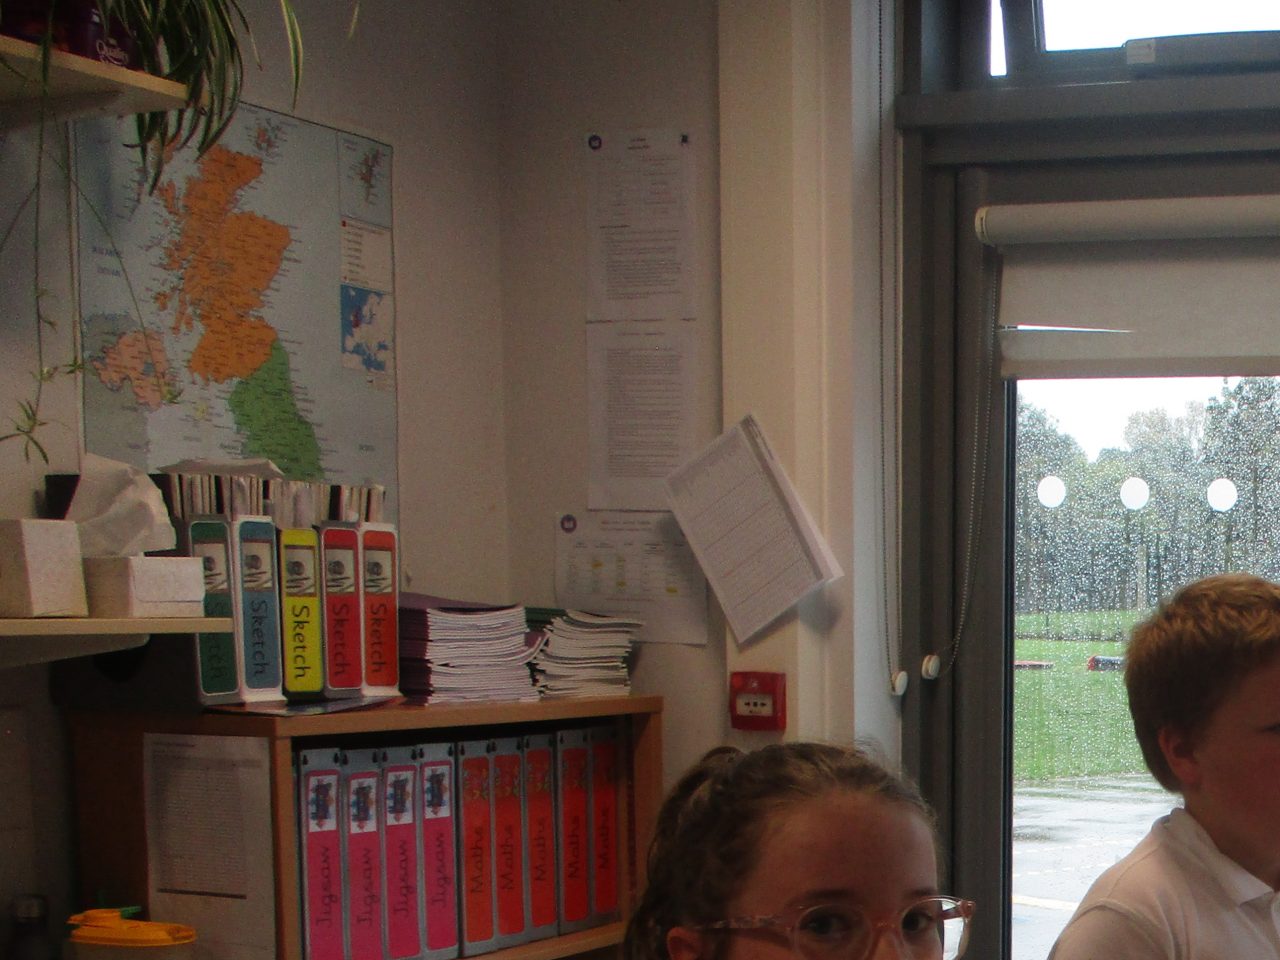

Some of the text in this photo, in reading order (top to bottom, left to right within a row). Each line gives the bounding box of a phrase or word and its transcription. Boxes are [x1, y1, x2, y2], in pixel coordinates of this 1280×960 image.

[250, 599, 270, 676] Sketch
[290, 604, 313, 679] Sketch
[331, 603, 352, 677] Sketch
[369, 603, 388, 674] Sketch
[430, 831, 453, 910] Jigsaw
[469, 825, 485, 894] Maths
[500, 824, 514, 891] Maths
[534, 816, 547, 882] Maths
[566, 815, 581, 881] Maths
[597, 807, 610, 872] Maths
[315, 845, 339, 929] Jigsaw
[356, 847, 381, 926] Jigsaw
[392, 839, 418, 918] Jigsaw
